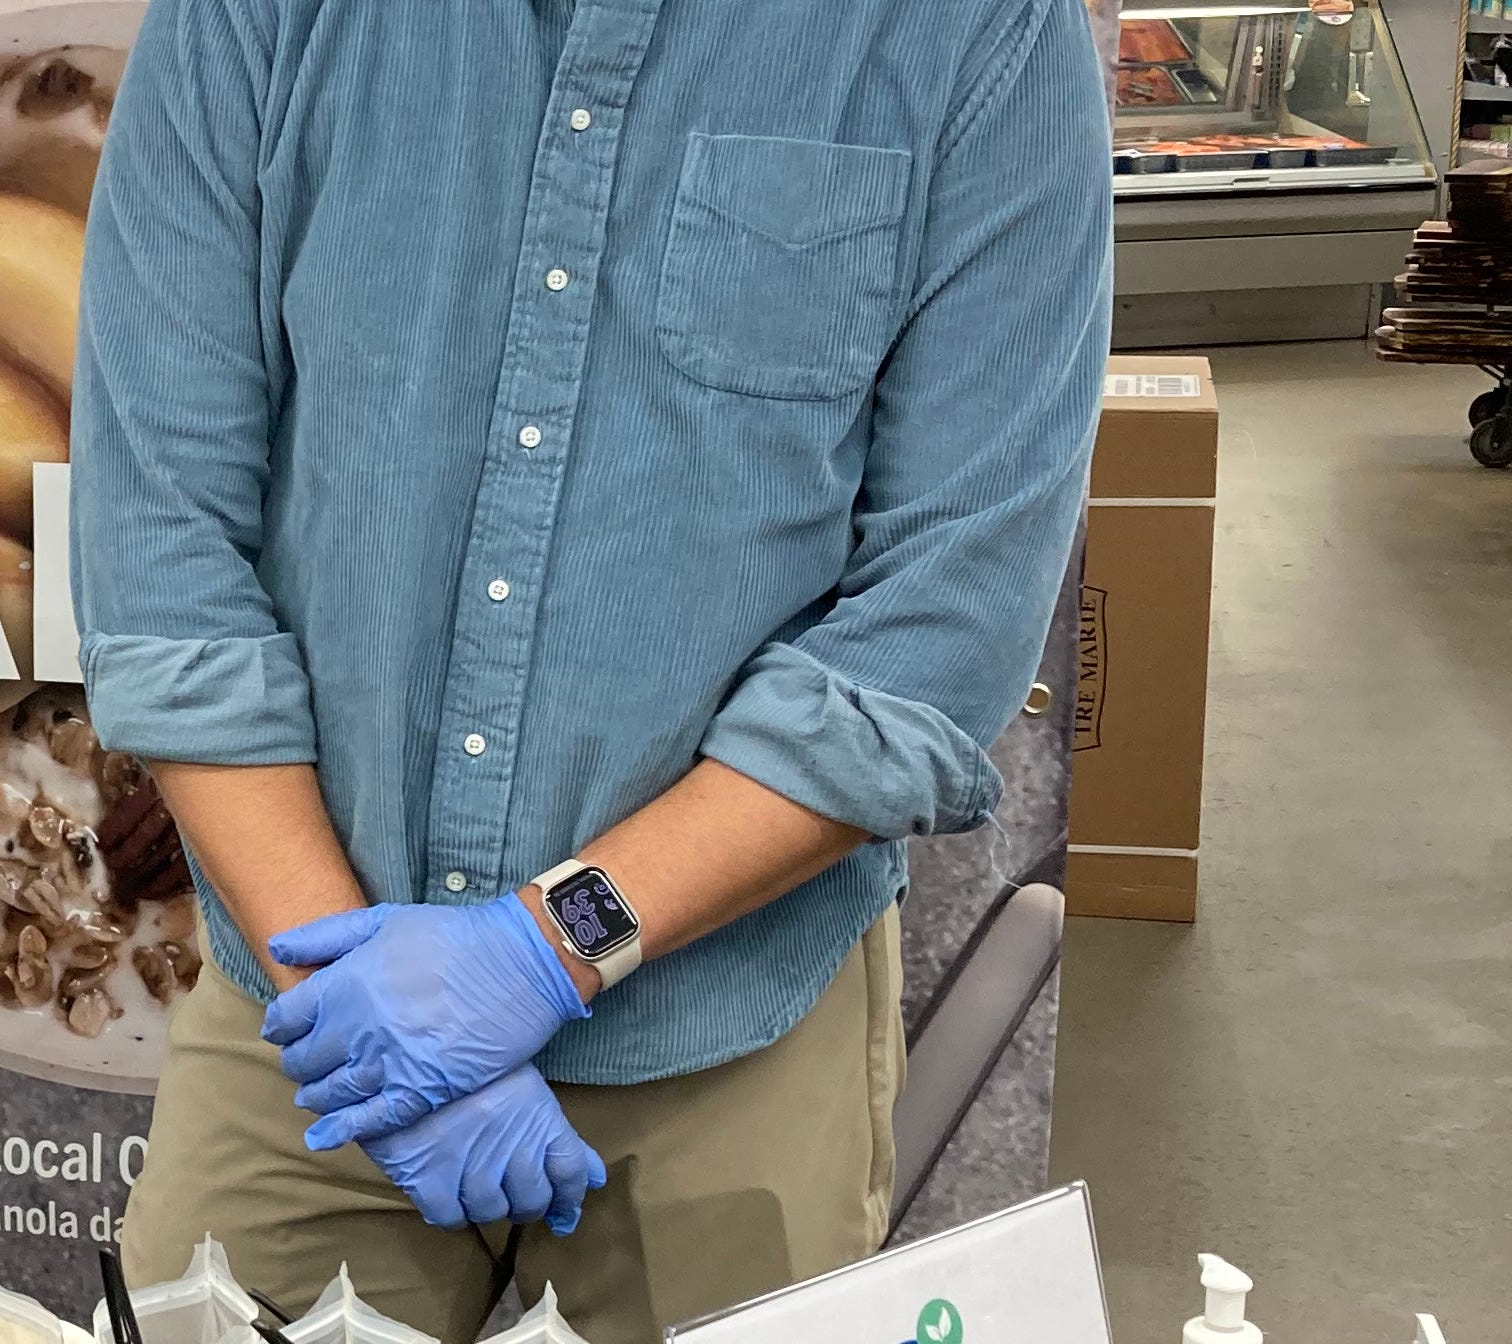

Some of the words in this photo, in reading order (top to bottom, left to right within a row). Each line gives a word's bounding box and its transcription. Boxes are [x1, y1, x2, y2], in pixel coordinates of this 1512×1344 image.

[1080, 599, 1098, 682] MARIE
[1074, 690, 1097, 738] TRE
[574, 913, 608, 946] 10
